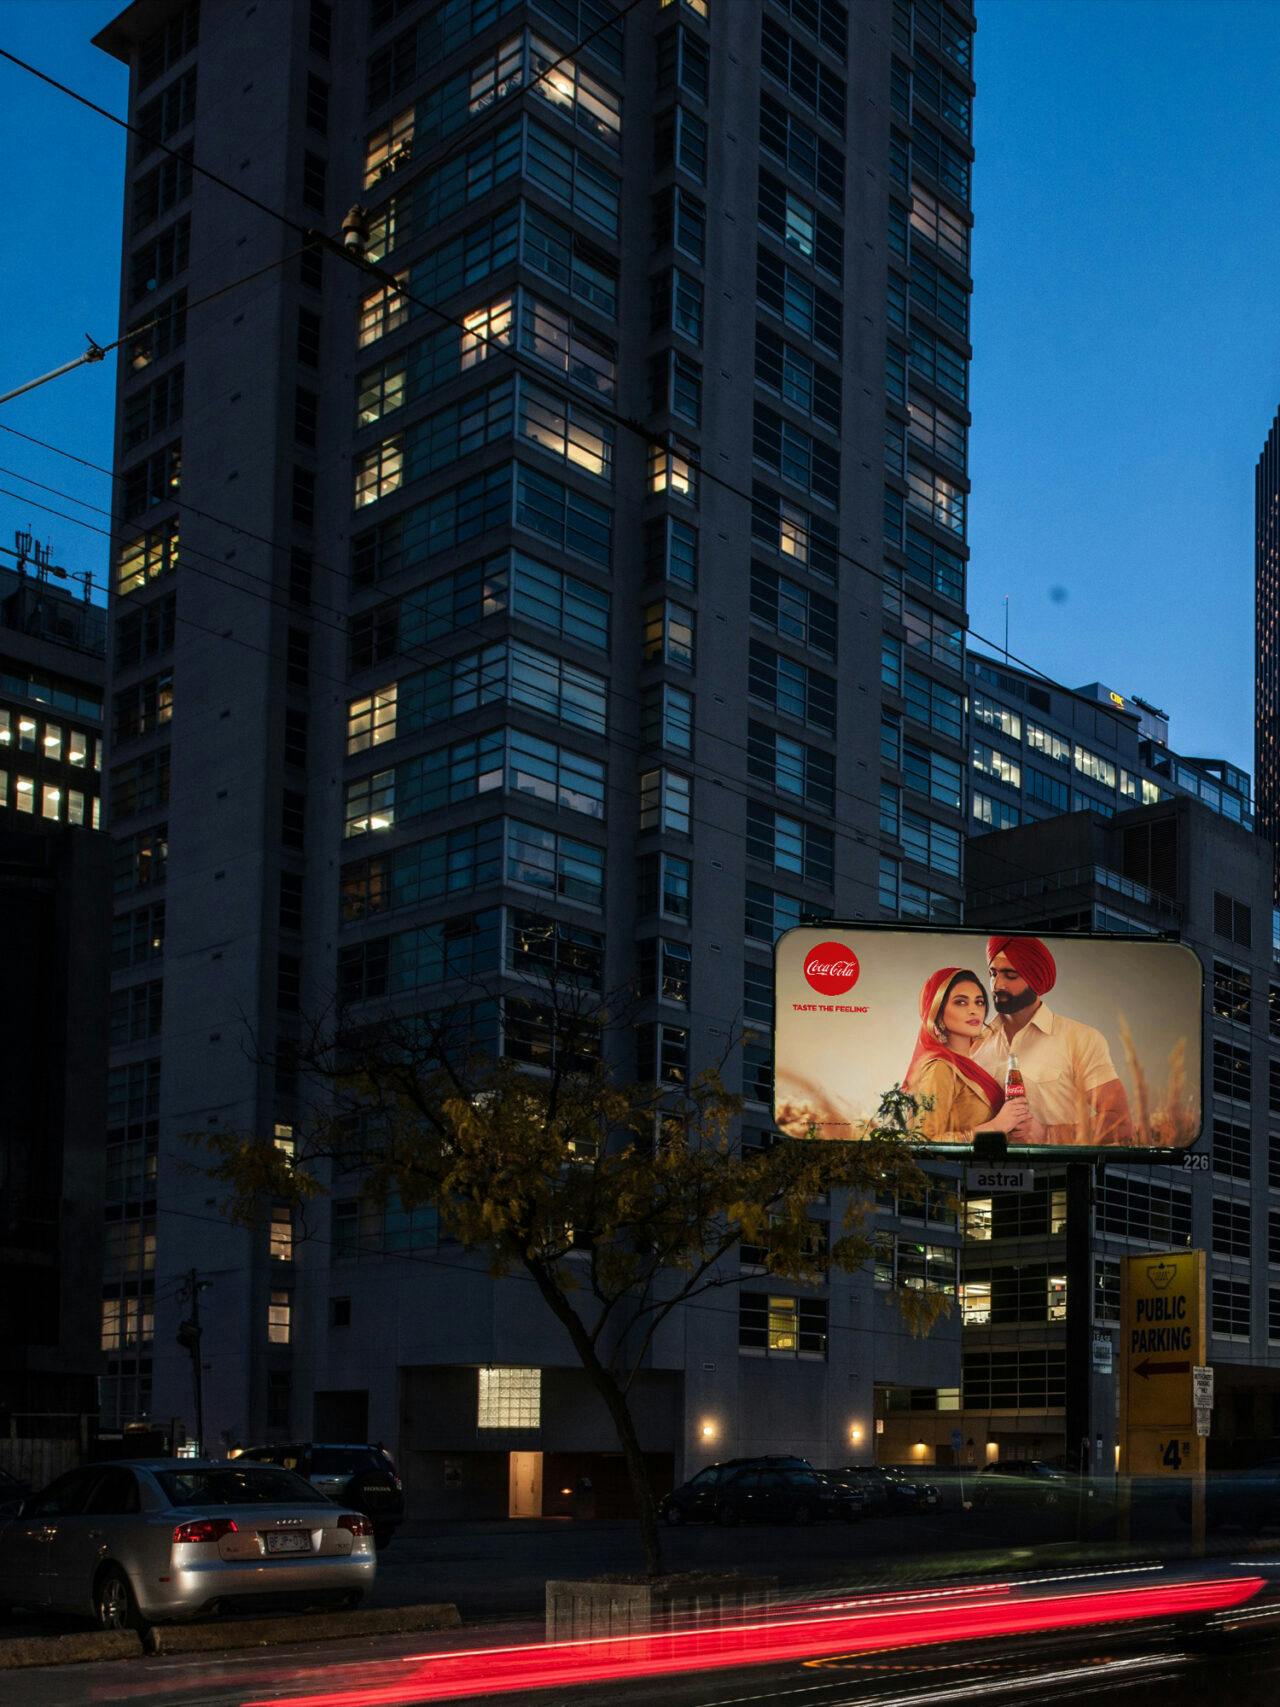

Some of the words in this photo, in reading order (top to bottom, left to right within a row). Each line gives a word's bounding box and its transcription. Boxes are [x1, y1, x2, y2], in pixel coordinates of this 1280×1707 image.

[793, 1004, 817, 1012] TASTE
[835, 1005, 868, 1013] FEELING
[1183, 1154, 1209, 1170] 226
[978, 1172, 1024, 1187] astral
[1136, 1295, 1186, 1322] PUBLIC
[1131, 1326, 1191, 1353] PARKING
